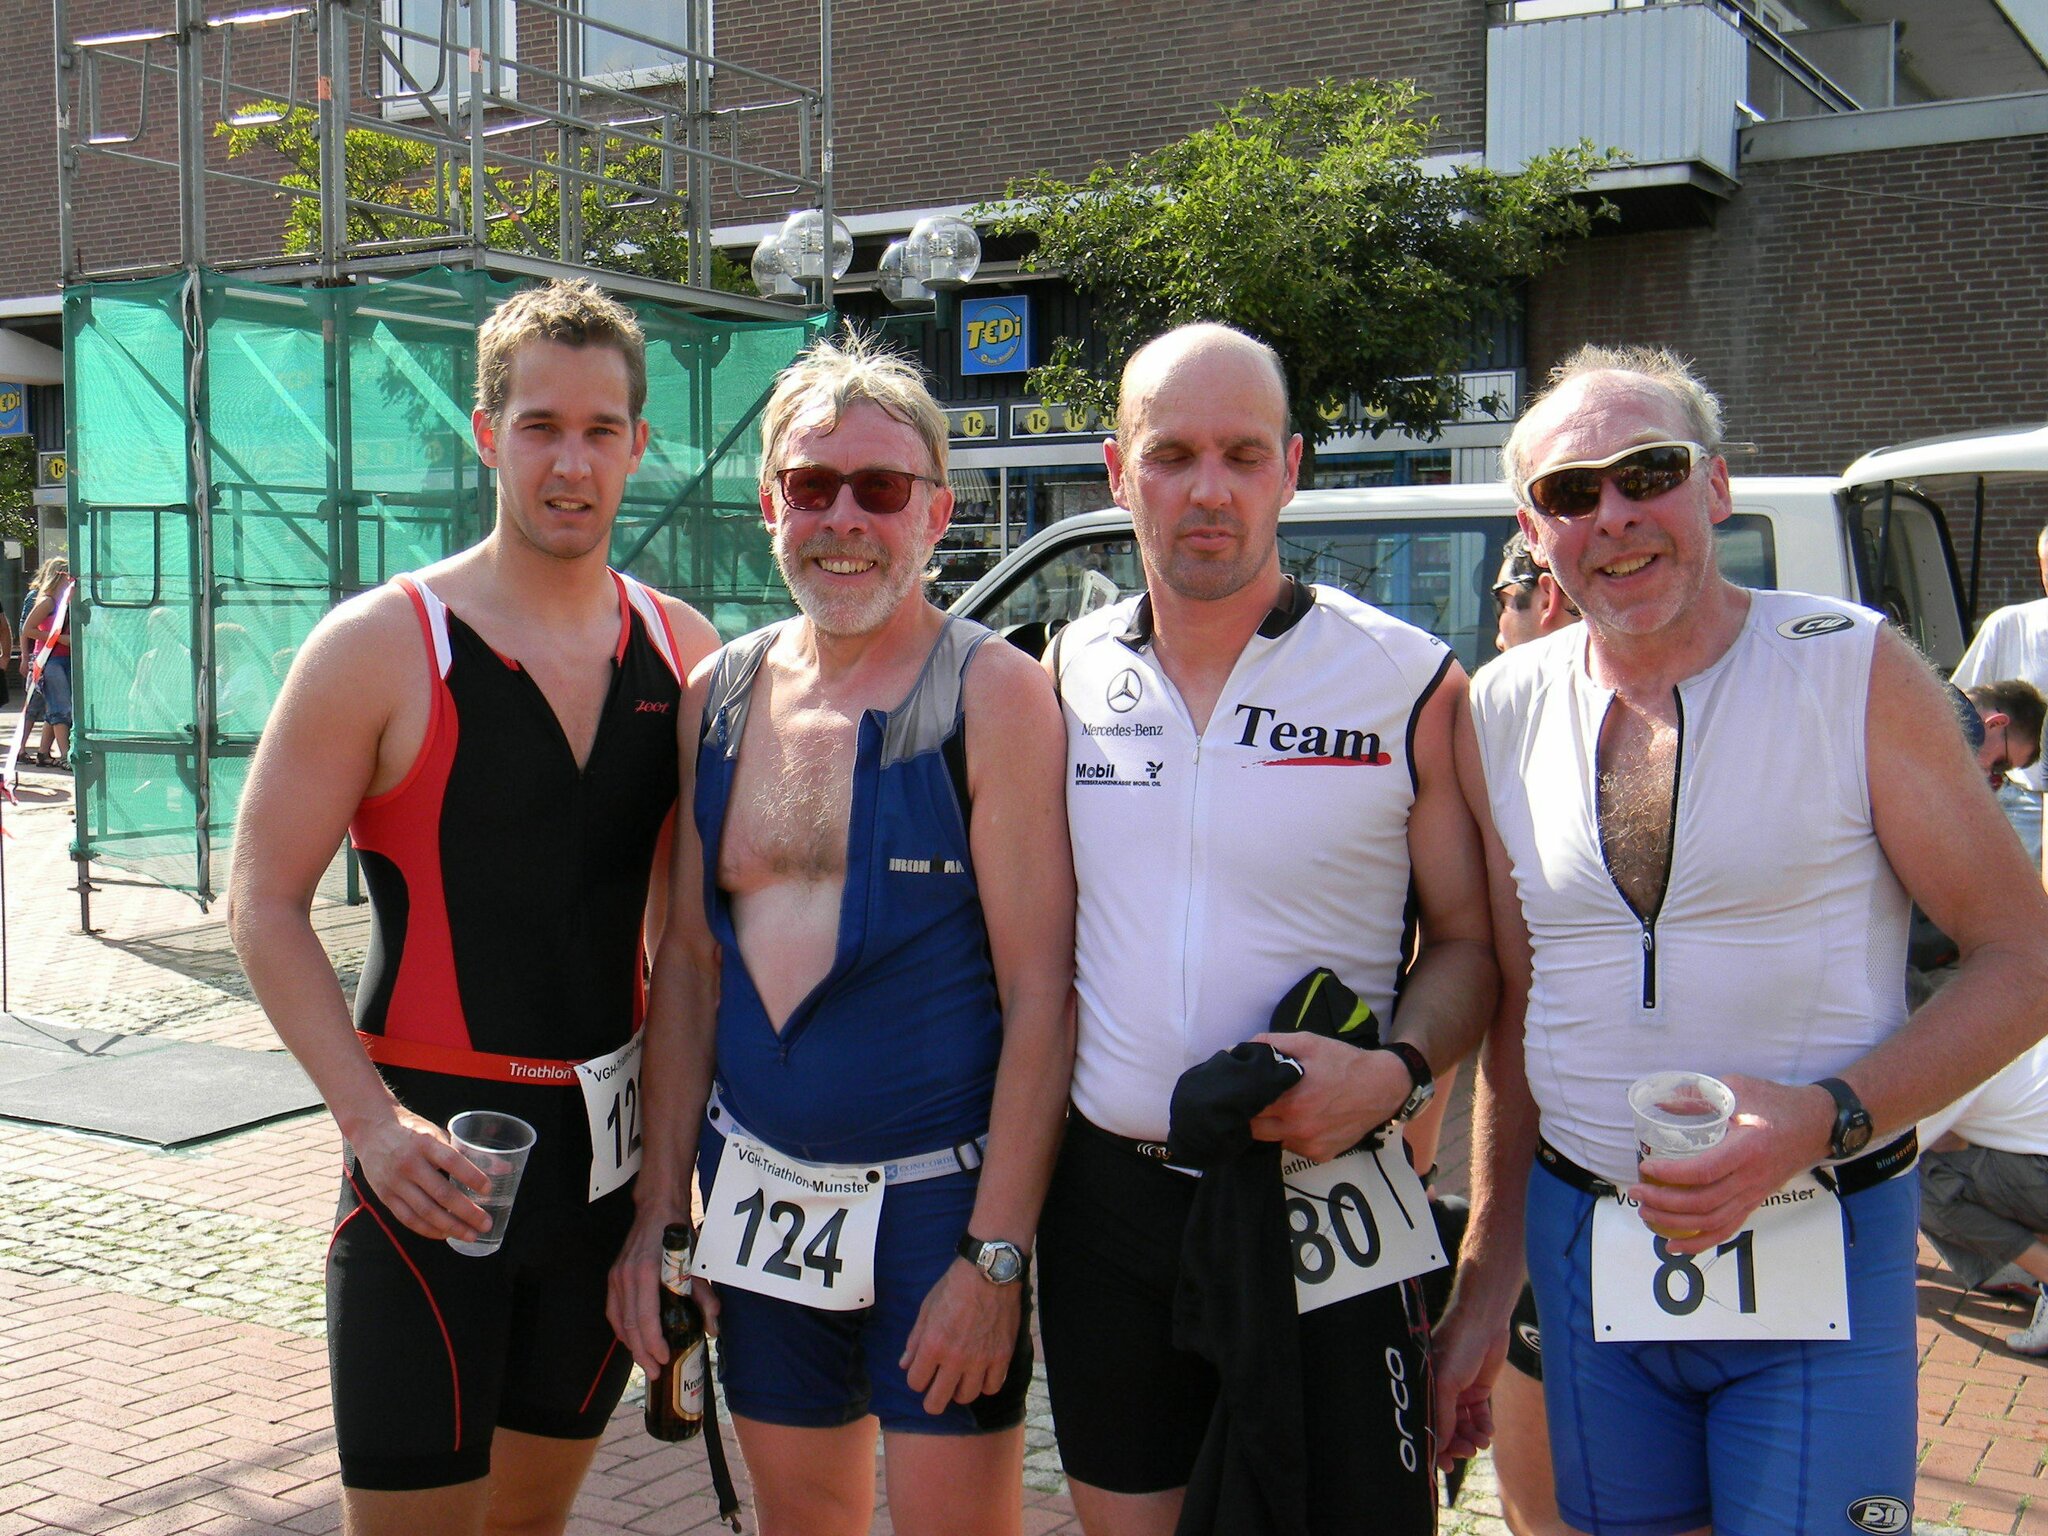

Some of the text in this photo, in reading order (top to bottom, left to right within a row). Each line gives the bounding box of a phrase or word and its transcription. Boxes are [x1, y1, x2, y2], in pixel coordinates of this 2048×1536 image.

[1075, 763, 1115, 778] Mobil
[1081, 723, 1164, 736] Mercedes-Benz
[1234, 703, 1382, 764] Team
[509, 1061, 572, 1080] Triathlon
[607, 1077, 641, 1169] 12
[733, 1187, 849, 1289] 124
[1286, 1182, 1381, 1285] 80
[1652, 1229, 1757, 1317] 81
[1385, 1346, 1417, 1473] orca
